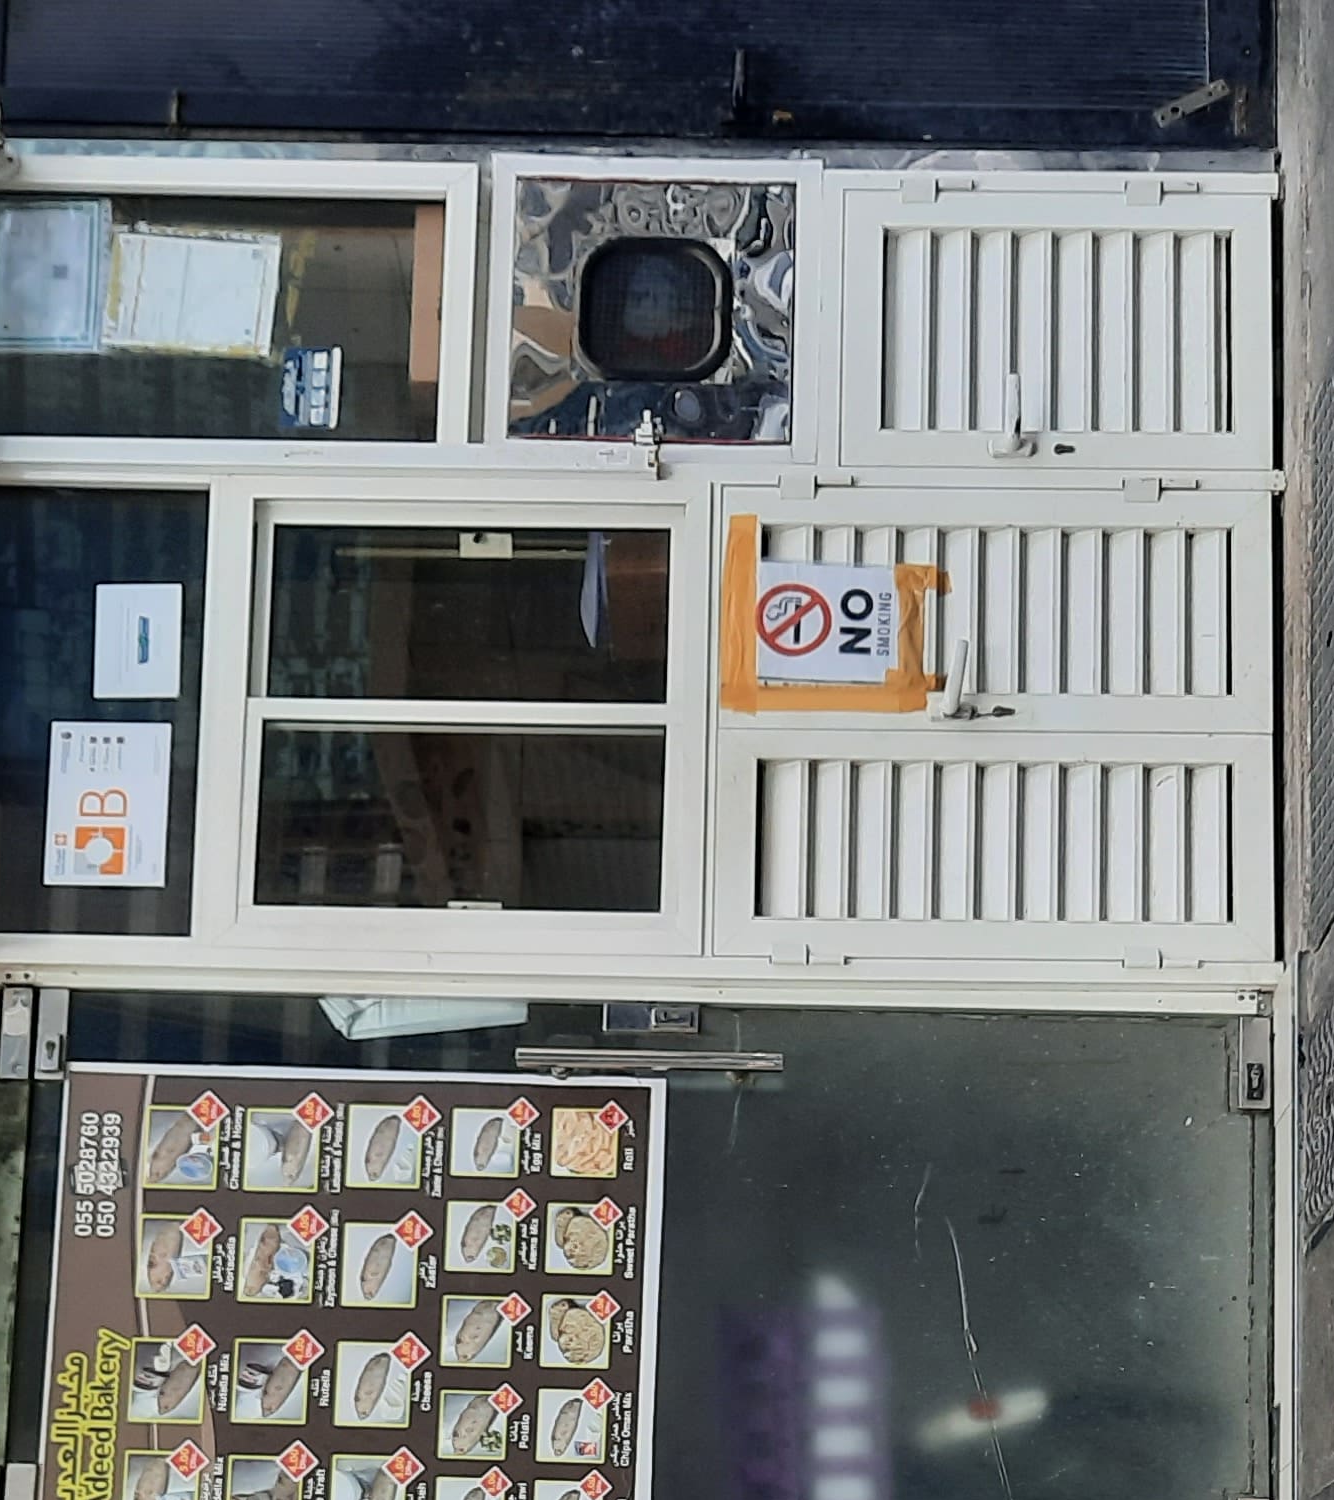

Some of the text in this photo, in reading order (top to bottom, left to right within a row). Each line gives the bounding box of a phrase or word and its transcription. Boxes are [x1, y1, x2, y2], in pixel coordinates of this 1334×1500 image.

[838, 588, 874, 656] NO
[875, 591, 892, 657] SMOKING
[78, 788, 128, 818] B
[74, 1112, 100, 1237] 055 5028760
[96, 1112, 122, 1237] 050 4322939
[530, 1132, 543, 1172] Egg Mix
[224, 1236, 236, 1291] Mortadella
[624, 1206, 636, 1279] Sweet Paratha
[622, 1310, 635, 1354] Paratha
[55, 1354, 88, 1420] مخبز
[89, 1329, 130, 1421] Bakery
[217, 1374, 229, 1411] Nutella
[319, 1369, 331, 1407] Nutella
[420, 1371, 433, 1411] Cheese
[518, 1414, 531, 1449] Potato
[620, 1392, 633, 1467] Chips Oman Mix
